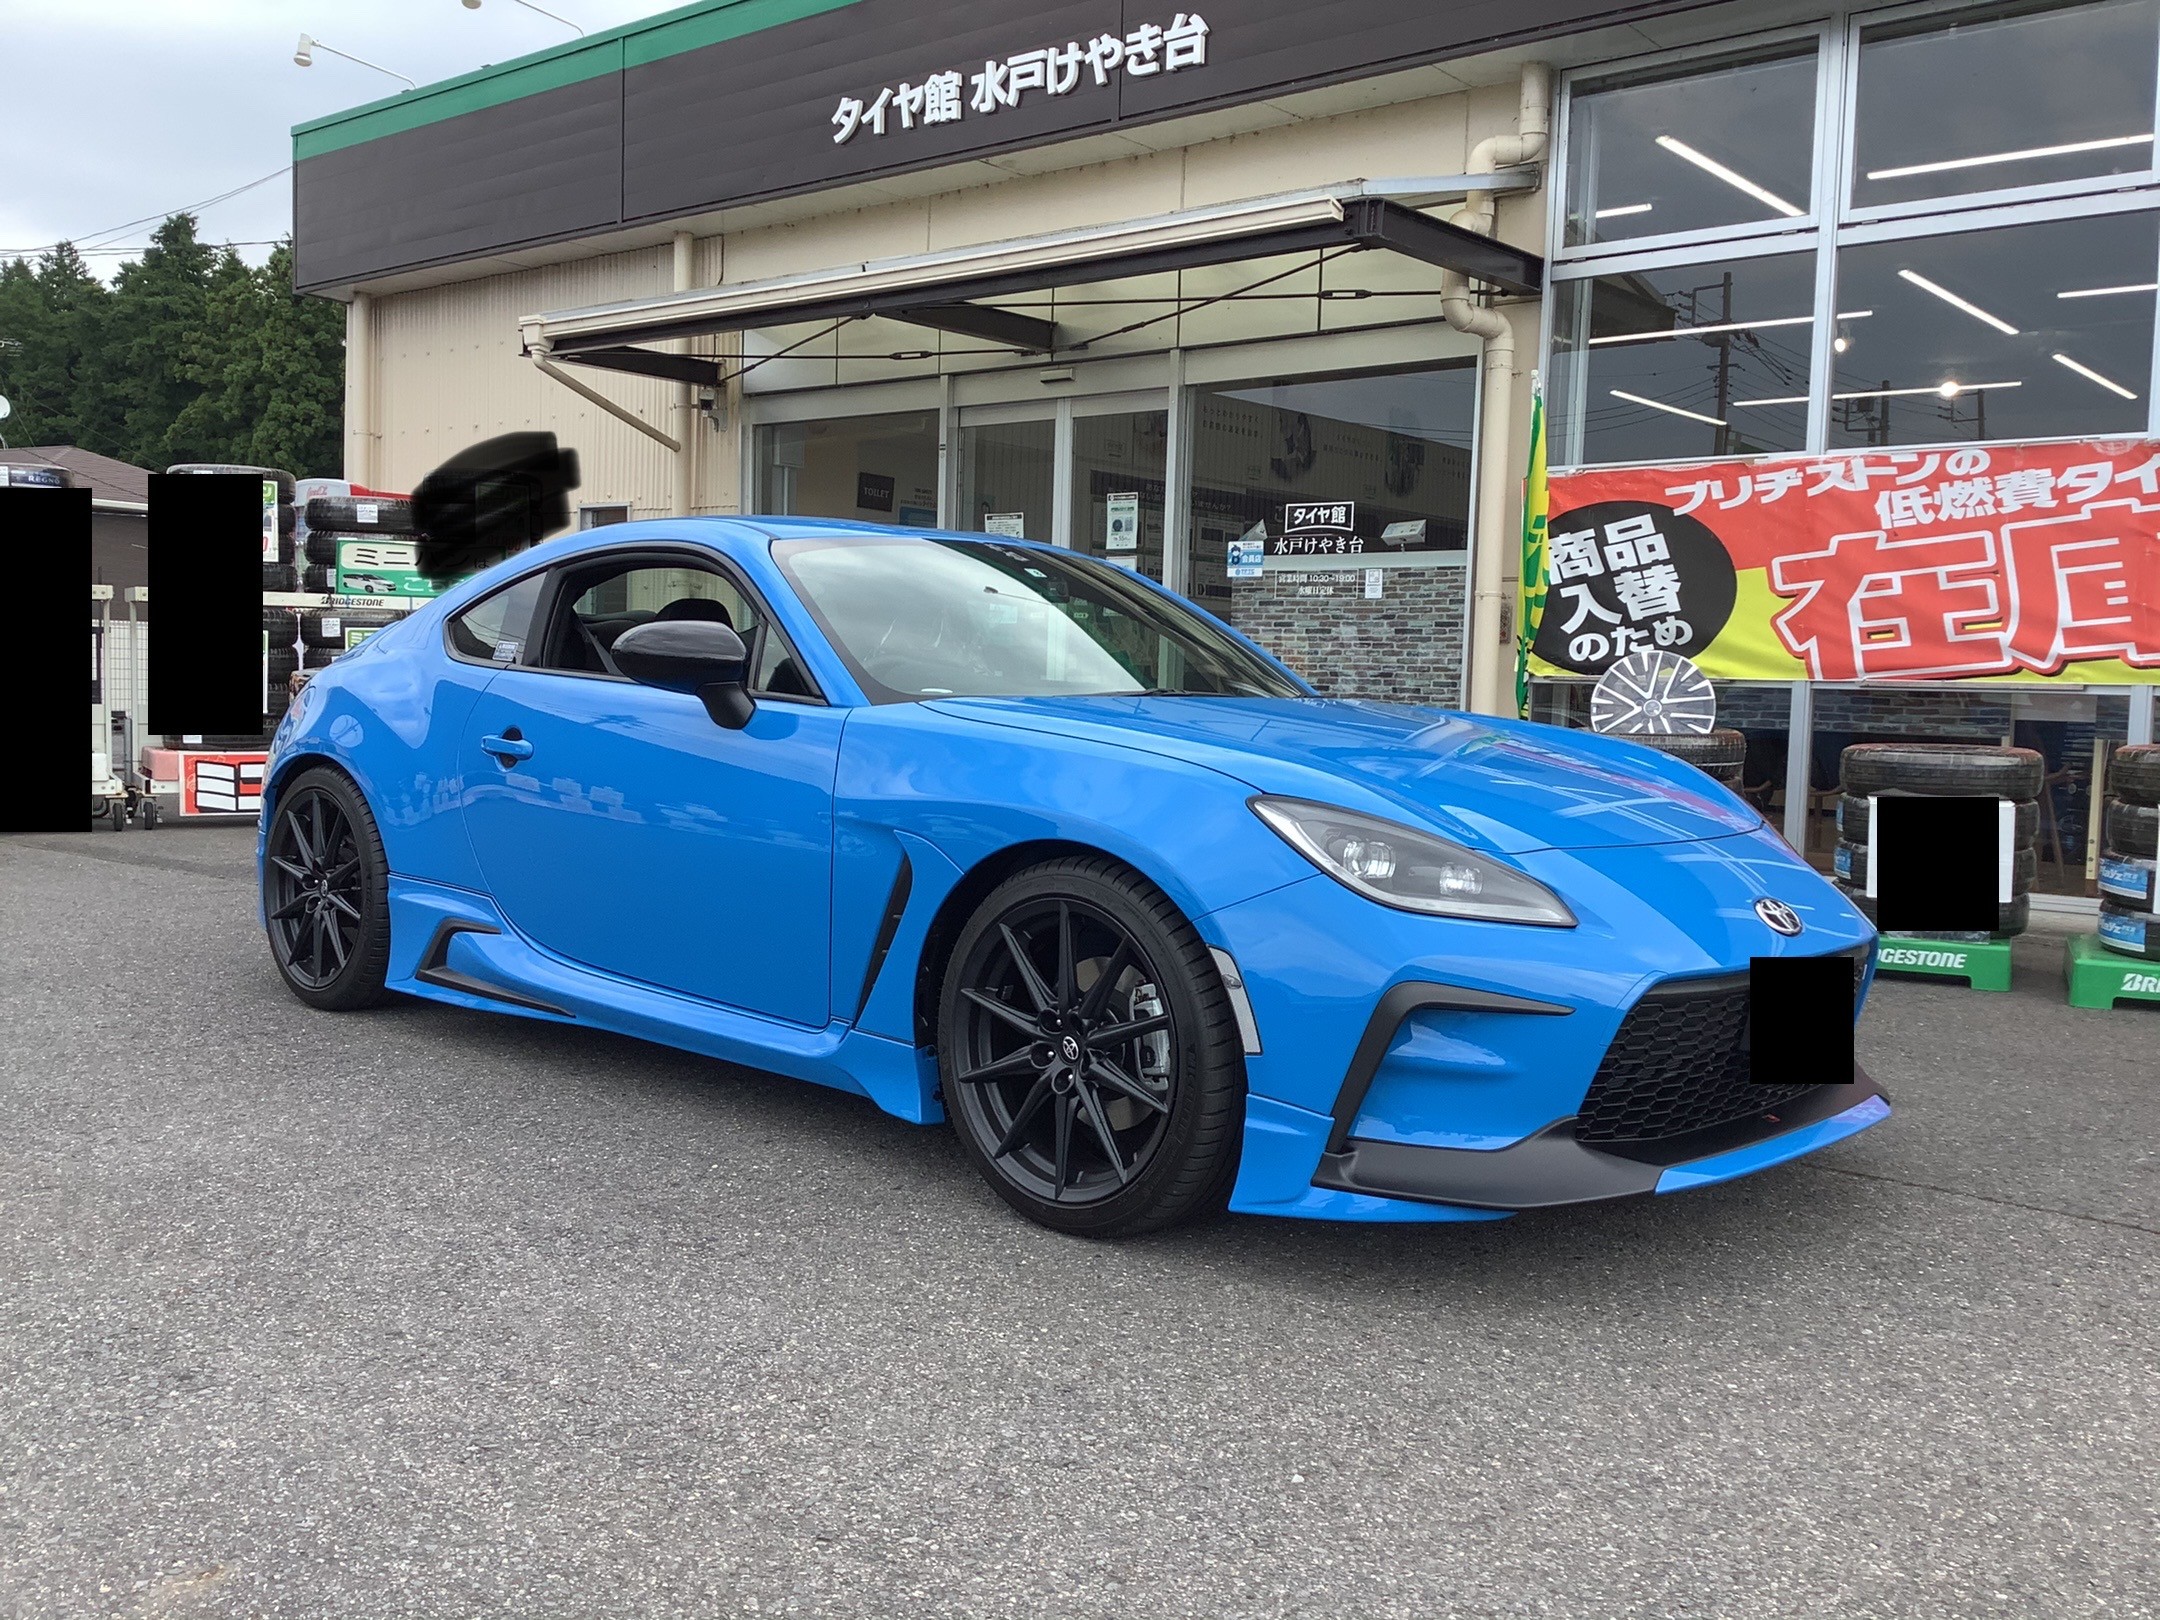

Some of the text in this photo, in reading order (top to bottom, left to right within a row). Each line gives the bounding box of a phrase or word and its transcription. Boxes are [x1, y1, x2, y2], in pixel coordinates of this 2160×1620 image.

[831, 13, 1209, 144] タイヤ館 水戸けやき台
[28, 475, 60, 485] REGNO
[1665, 449, 1991, 517] ブリヂストンの
[863, 486, 890, 499] TOILET
[1293, 506, 1346, 525] タイヤ館
[1273, 535, 1364, 555] 水戸けやき台
[1549, 514, 1671, 585] 商品
[320, 596, 385, 607] BRIDGESTONE
[1560, 564, 1682, 634] 入替
[1569, 615, 1693, 661] のため
[1877, 948, 1967, 969] GESTONE
